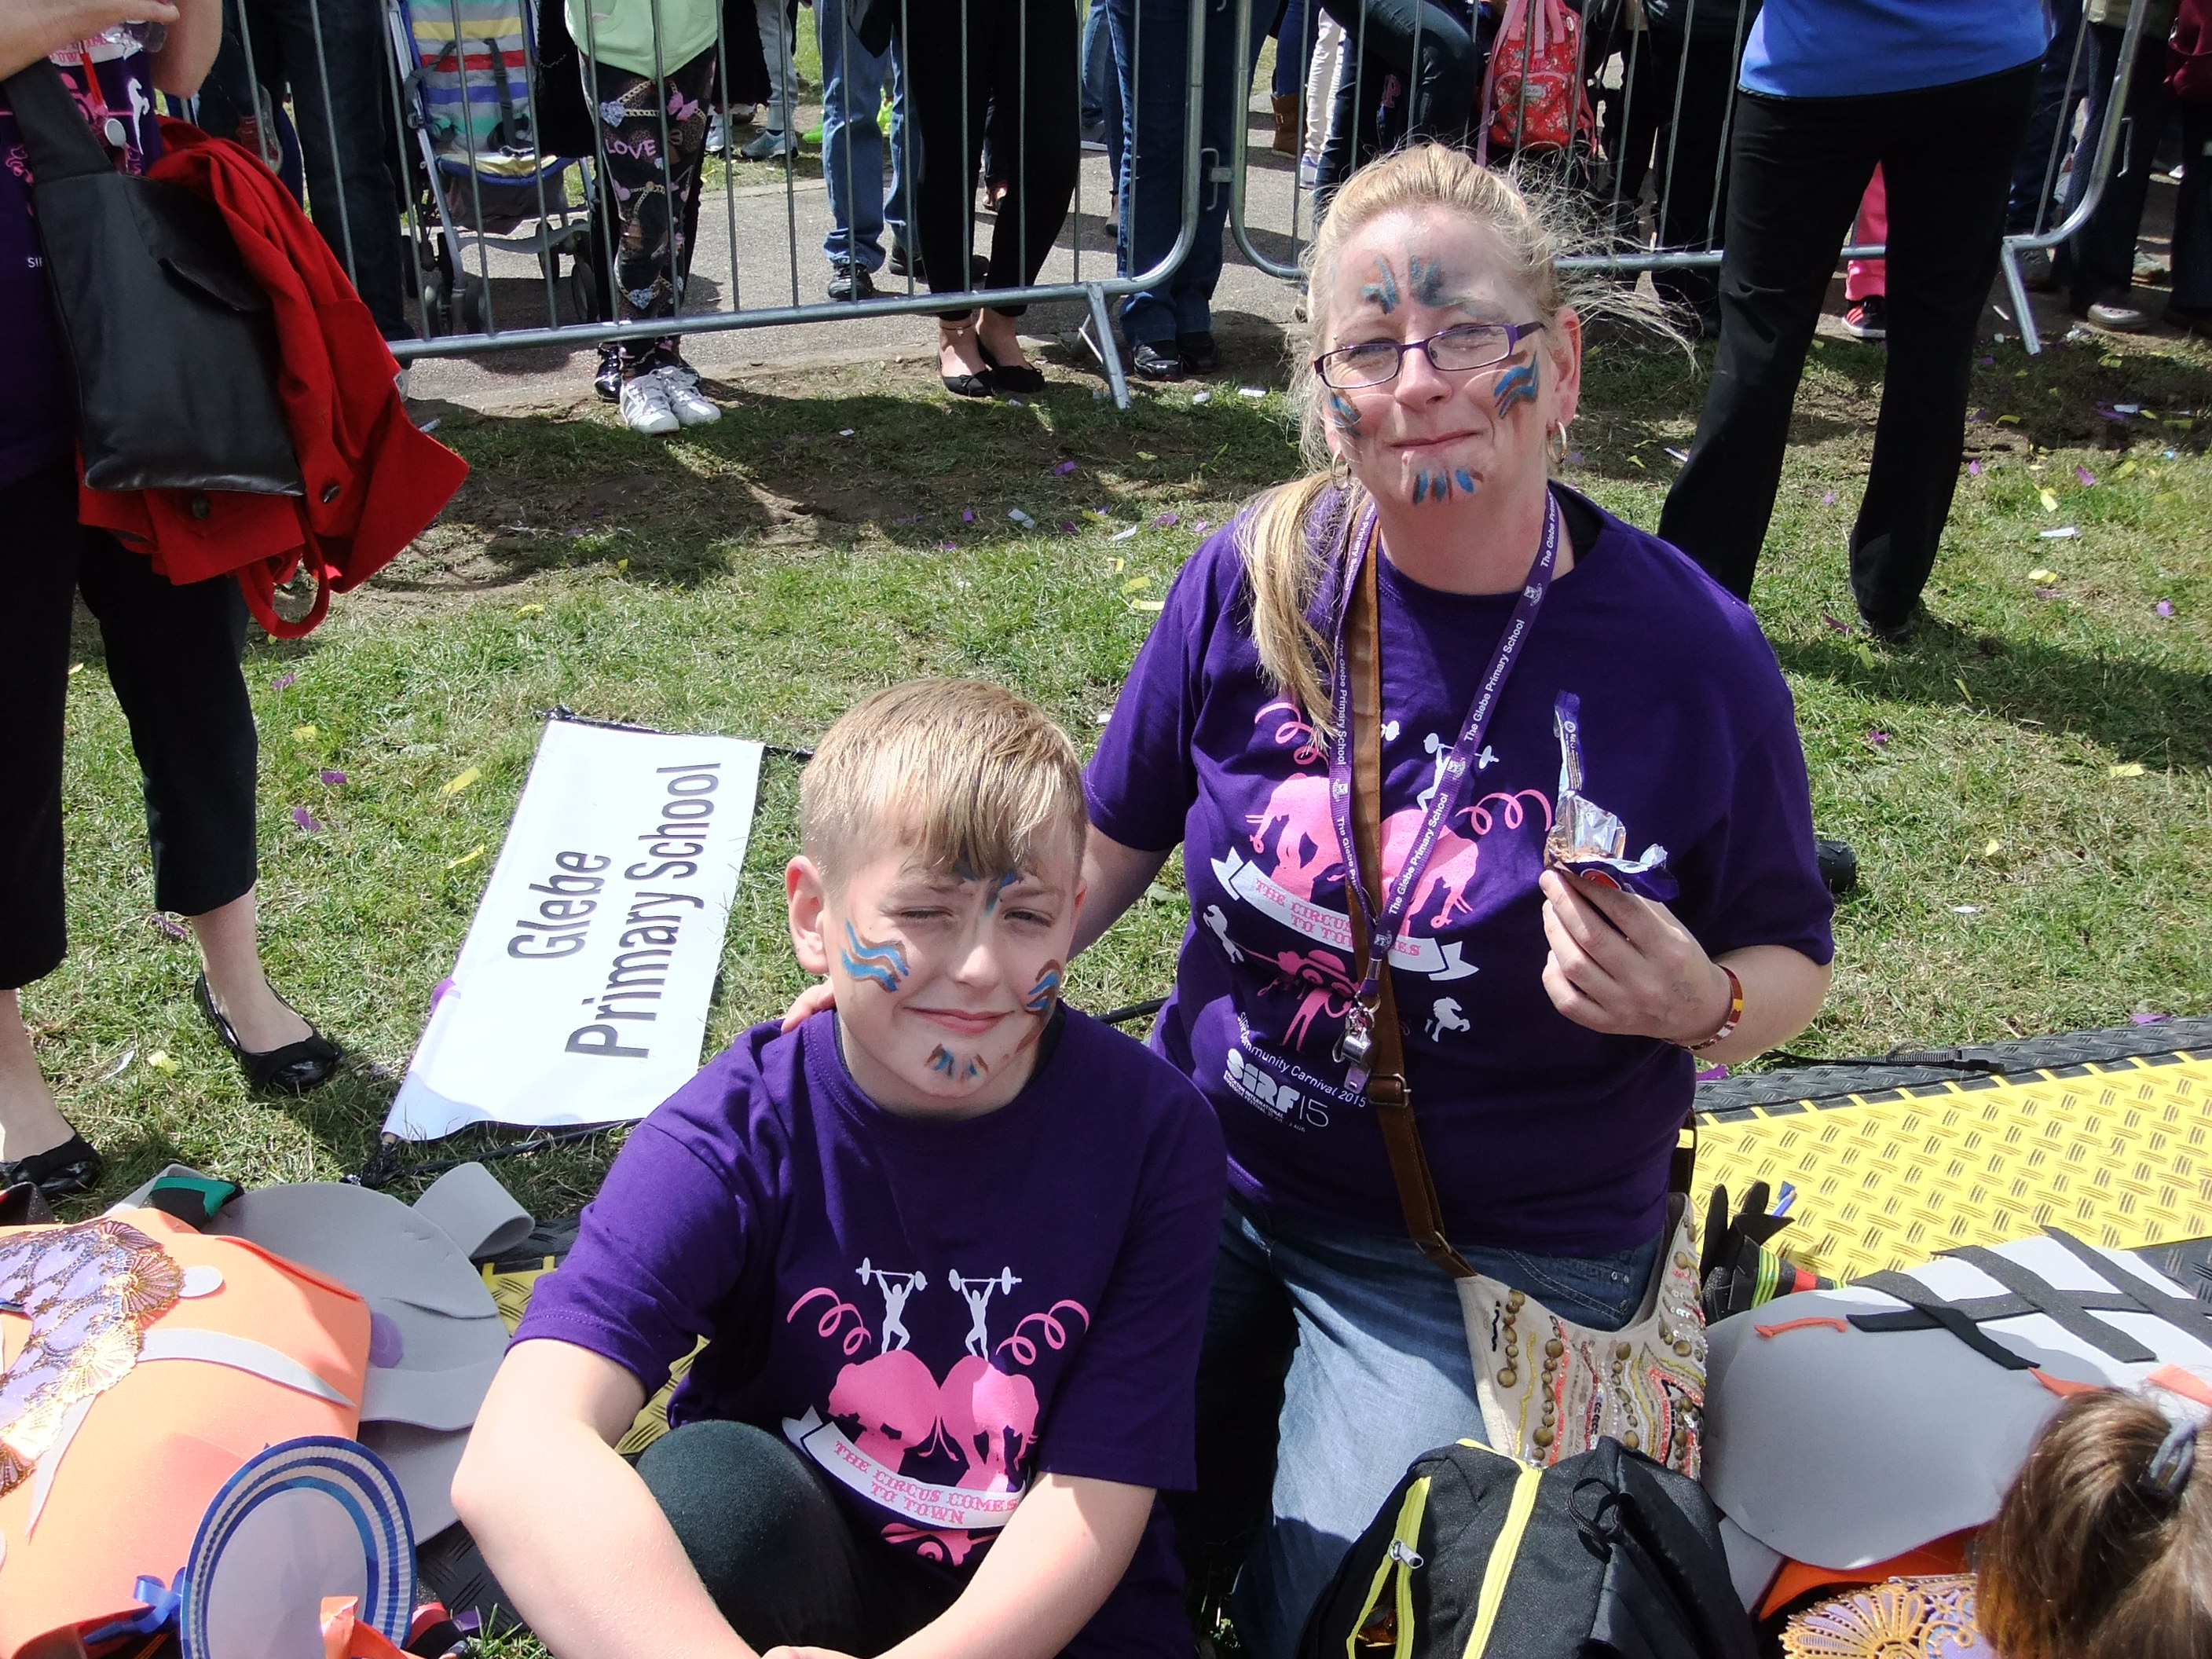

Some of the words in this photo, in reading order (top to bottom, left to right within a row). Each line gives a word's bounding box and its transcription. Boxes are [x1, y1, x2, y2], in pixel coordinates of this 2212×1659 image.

[604, 138, 657, 159] LOVE
[1351, 522, 1369, 557] Primary
[1540, 550, 1551, 568] The
[1546, 523, 1555, 549] Glebe
[1463, 723, 1478, 742] The
[1473, 693, 1491, 722] Glebe
[1485, 654, 1510, 692] Primary
[1503, 619, 1525, 654] School
[1336, 689, 1348, 731] Primary
[1337, 730, 1347, 765] School
[624, 763, 721, 881] School
[1337, 816, 1346, 836] The
[1342, 837, 1354, 867] Glebe
[1389, 896, 1403, 914] The
[1397, 866, 1415, 895] Glebe
[1410, 828, 1434, 865] Primary
[1428, 793, 1448, 827] School
[507, 851, 612, 960] Glebe
[1256, 879, 1287, 907] THE
[1291, 913, 1316, 933] TO
[564, 892, 705, 1060] Primary
[1241, 1030, 1291, 1073] Community
[1291, 1065, 1339, 1097] Carnival
[1338, 1090, 1367, 1108] 2015
[834, 1441, 871, 1474] THE
[873, 1469, 944, 1503] CIRCUS
[947, 1492, 1020, 1513] COMES
[870, 1482, 898, 1503] TO
[903, 1496, 965, 1525] TOWN
